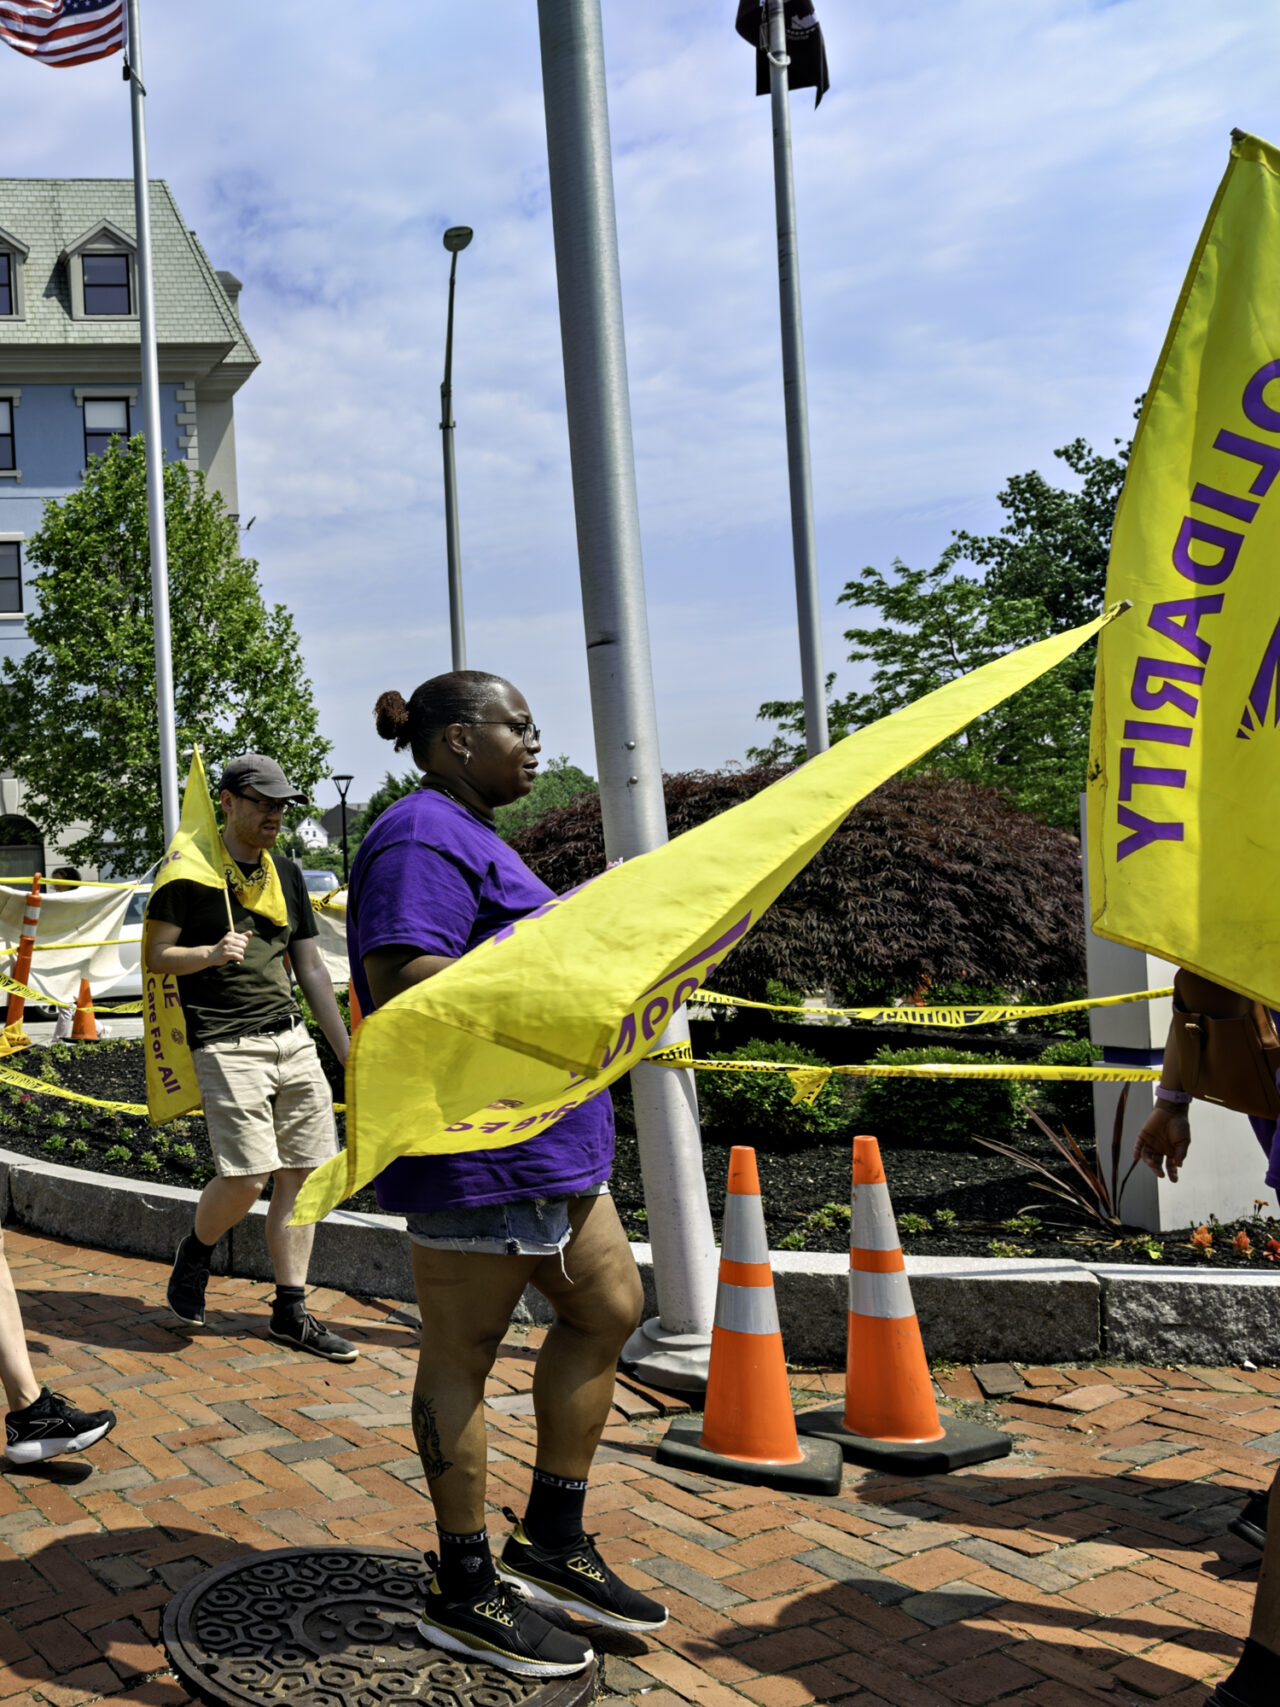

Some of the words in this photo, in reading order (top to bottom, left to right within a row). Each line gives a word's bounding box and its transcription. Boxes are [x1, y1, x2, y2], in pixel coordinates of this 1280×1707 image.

[147, 977, 157, 1025] Care
[882, 1009, 965, 1025] CAUTION
[150, 1026, 165, 1061] For
[157, 1065, 182, 1095] All
